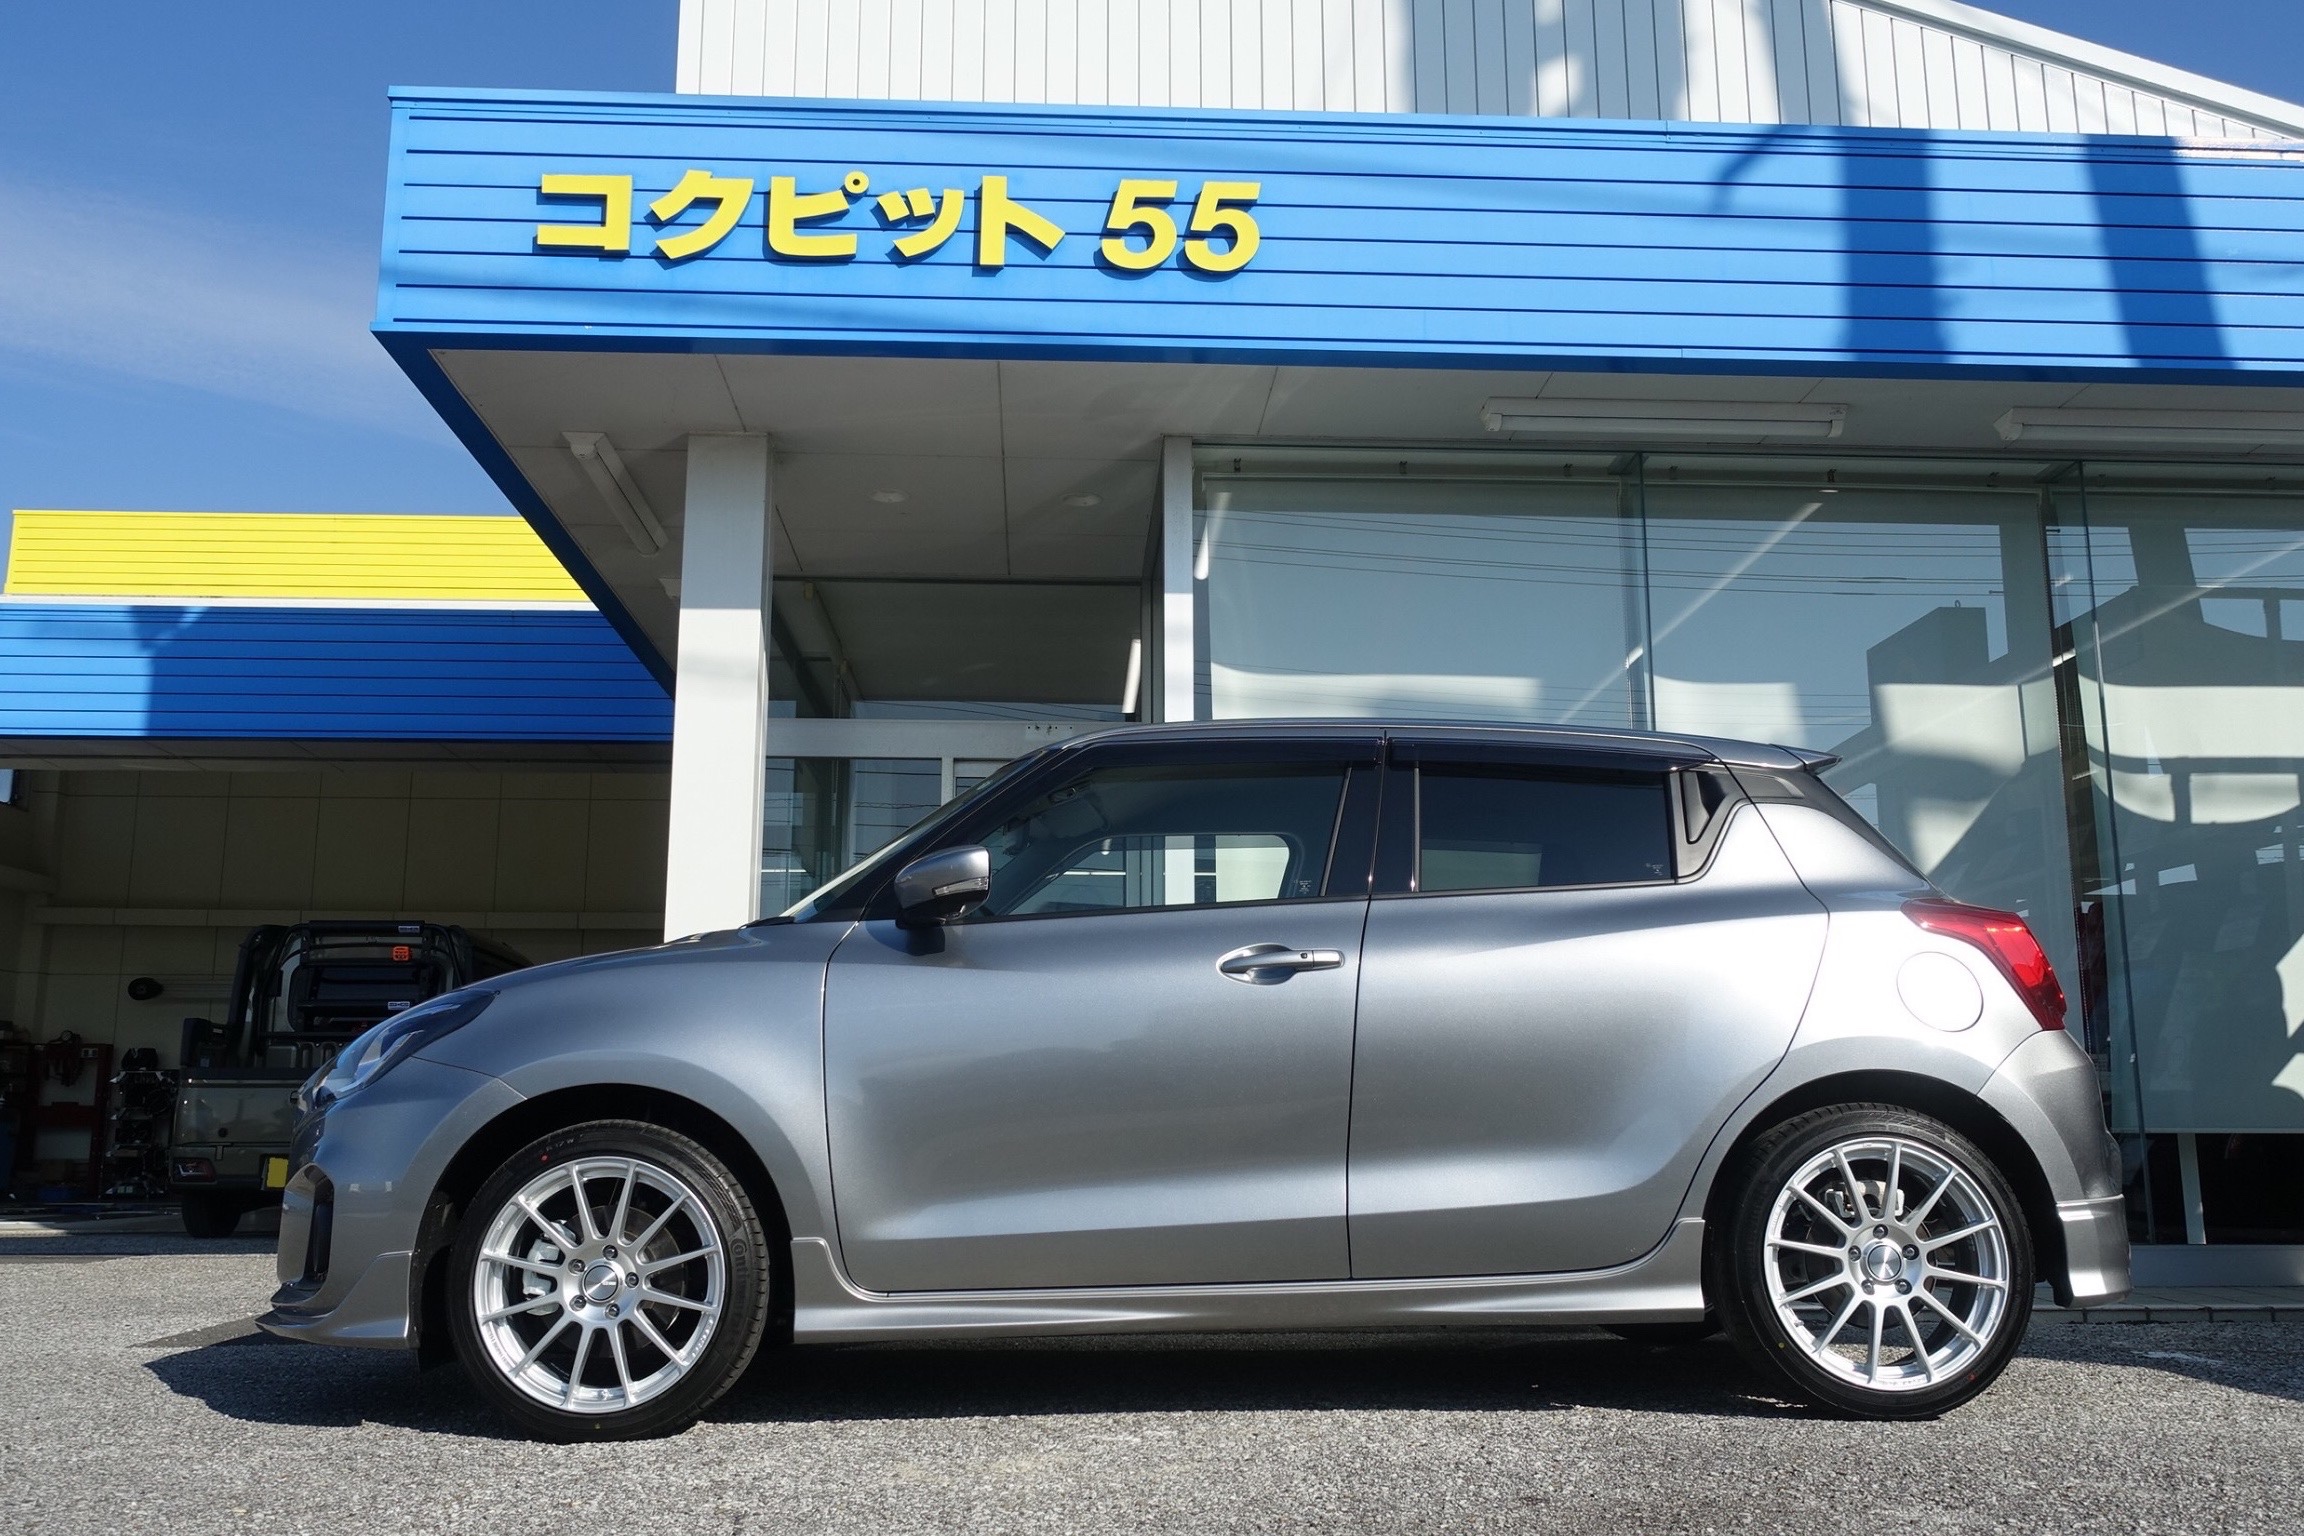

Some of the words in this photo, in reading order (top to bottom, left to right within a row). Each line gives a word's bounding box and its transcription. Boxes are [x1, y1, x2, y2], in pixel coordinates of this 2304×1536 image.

[536, 169, 1066, 268] コクピット
[1100, 179, 1262, 272] 55
